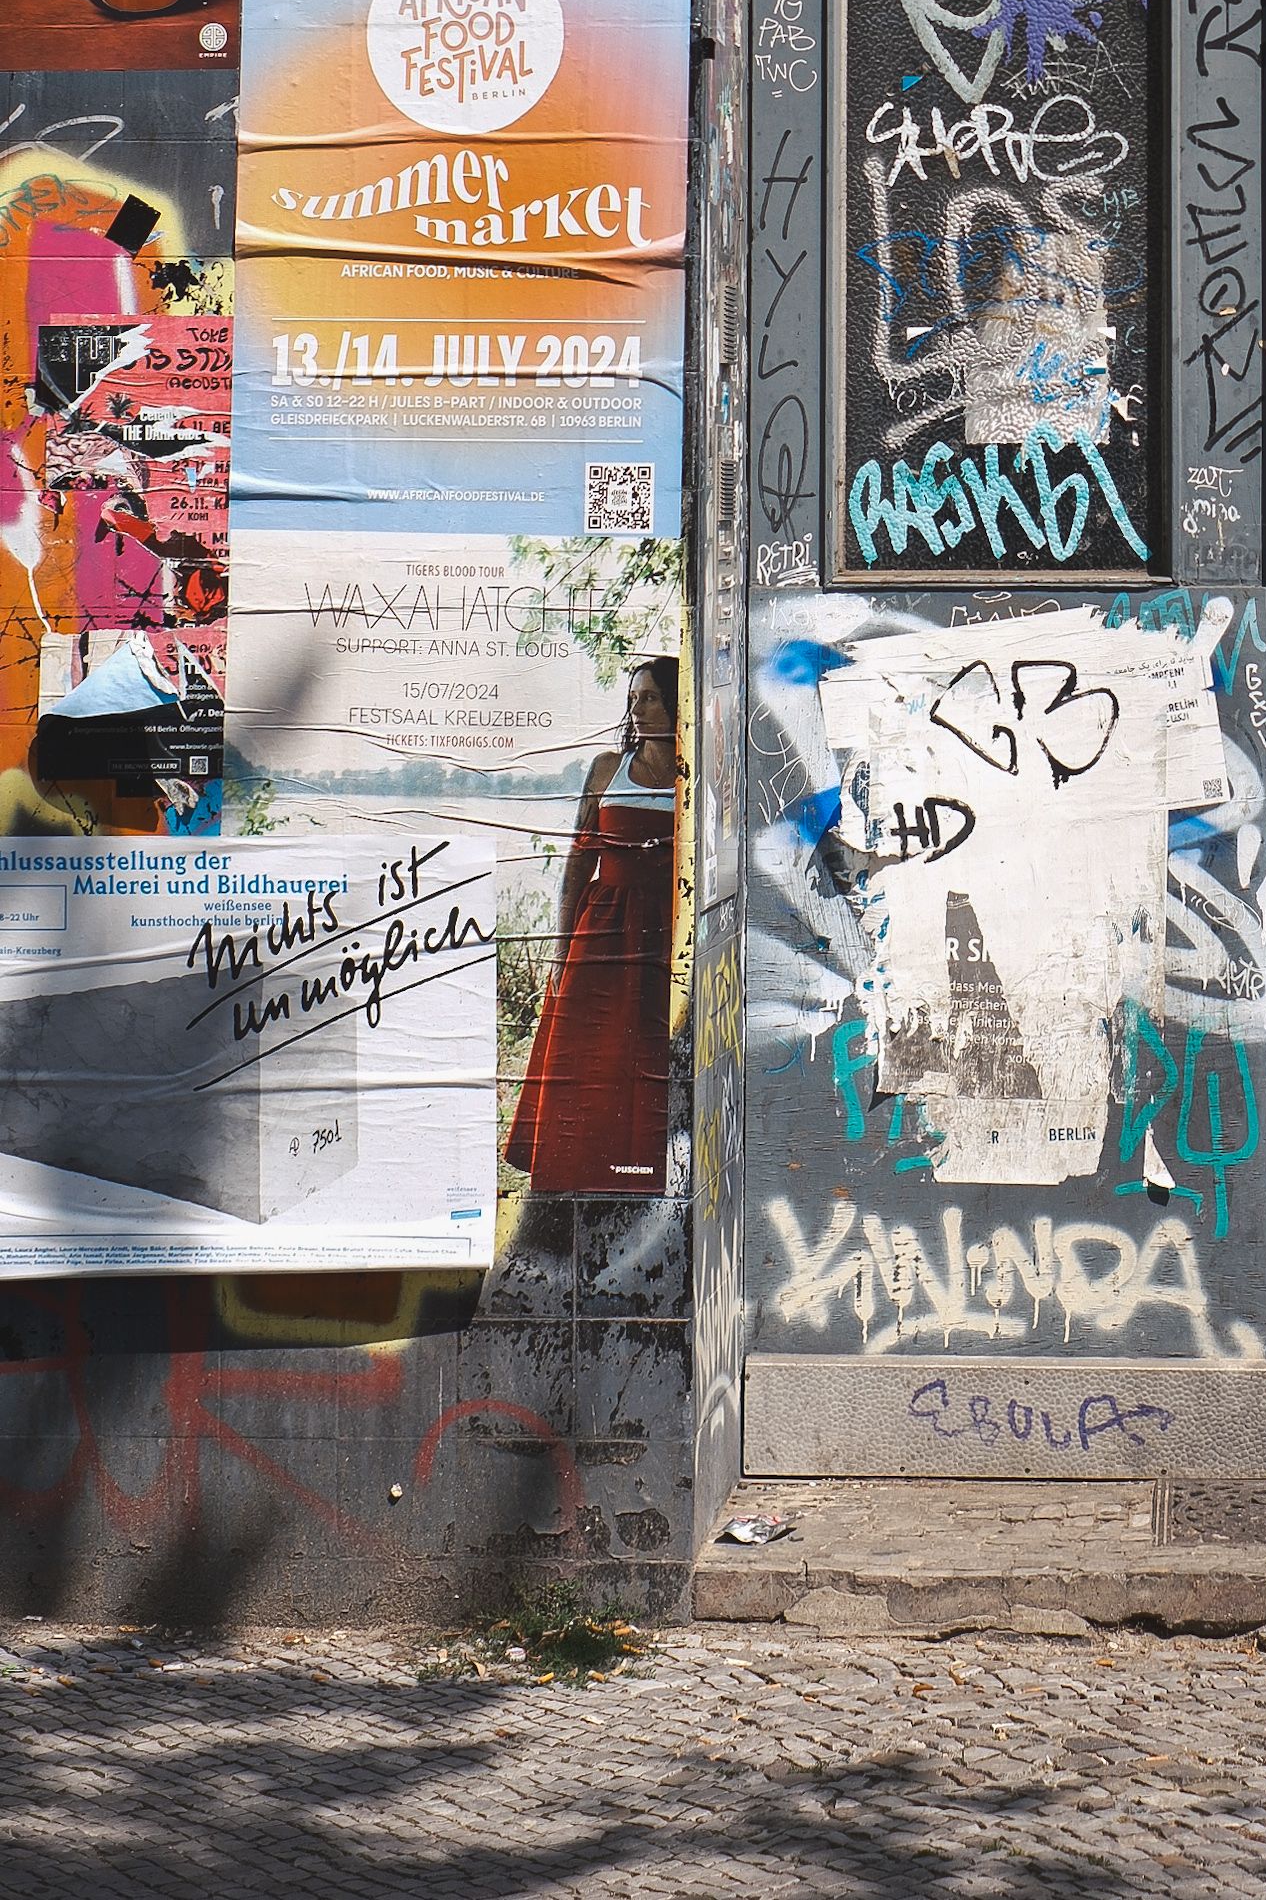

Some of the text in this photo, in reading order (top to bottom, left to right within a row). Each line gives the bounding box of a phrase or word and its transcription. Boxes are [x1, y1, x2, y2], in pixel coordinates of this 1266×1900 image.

[421, 11, 516, 61] FOOD
[199, 51, 228, 59] EMPIRE
[472, 88, 527, 101] BERLIN
[271, 149, 510, 221] summer
[414, 183, 652, 248] market
[341, 263, 579, 280] AFRICAN FOOD, MUSIC & CULTURE
[419, 334, 527, 389] JULY
[535, 335, 643, 389] 2024
[270, 396, 289, 408] SA
[292, 396, 303, 408] &
[368, 397, 379, 409] H
[389, 396, 431, 409] JULES
[498, 397, 554, 410] INDOOR
[557, 397, 568, 410] &
[571, 397, 643, 411] OUTDOOR
[270, 413, 388, 426] GLEISDREIECKPARK
[402, 414, 527, 428] LUCKENWALDERSTR.
[559, 416, 597, 428] 10963
[598, 416, 643, 429] BERLIN
[367, 490, 545, 502] WWW.AFRICANFOODFESTIVAL.DE
[406, 564, 505, 578] TIGERS BLOOD TOUR
[304, 582, 606, 634] WAXAHATCHEE
[336, 637, 569, 659] SUPPORT: ANNA ST. LOUIS
[402, 681, 499, 700] 15/07/2024
[349, 707, 553, 728] FESTSAAL KREUZBERG
[386, 733, 514, 749] TICKETS: TIXFORGIGS.COM
[194, 851, 231, 871] der
[378, 841, 450, 907] ist
[73, 873, 348, 895] Malerei und Bildhauerei
[204, 899, 272, 912] weißensee
[22, 913, 40, 922] Uhr
[131, 914, 284, 928] kunsthochschule berlin
[1048, 1127, 1097, 1142] BERLIN
[614, 1165, 654, 1175] PUSCHEN
